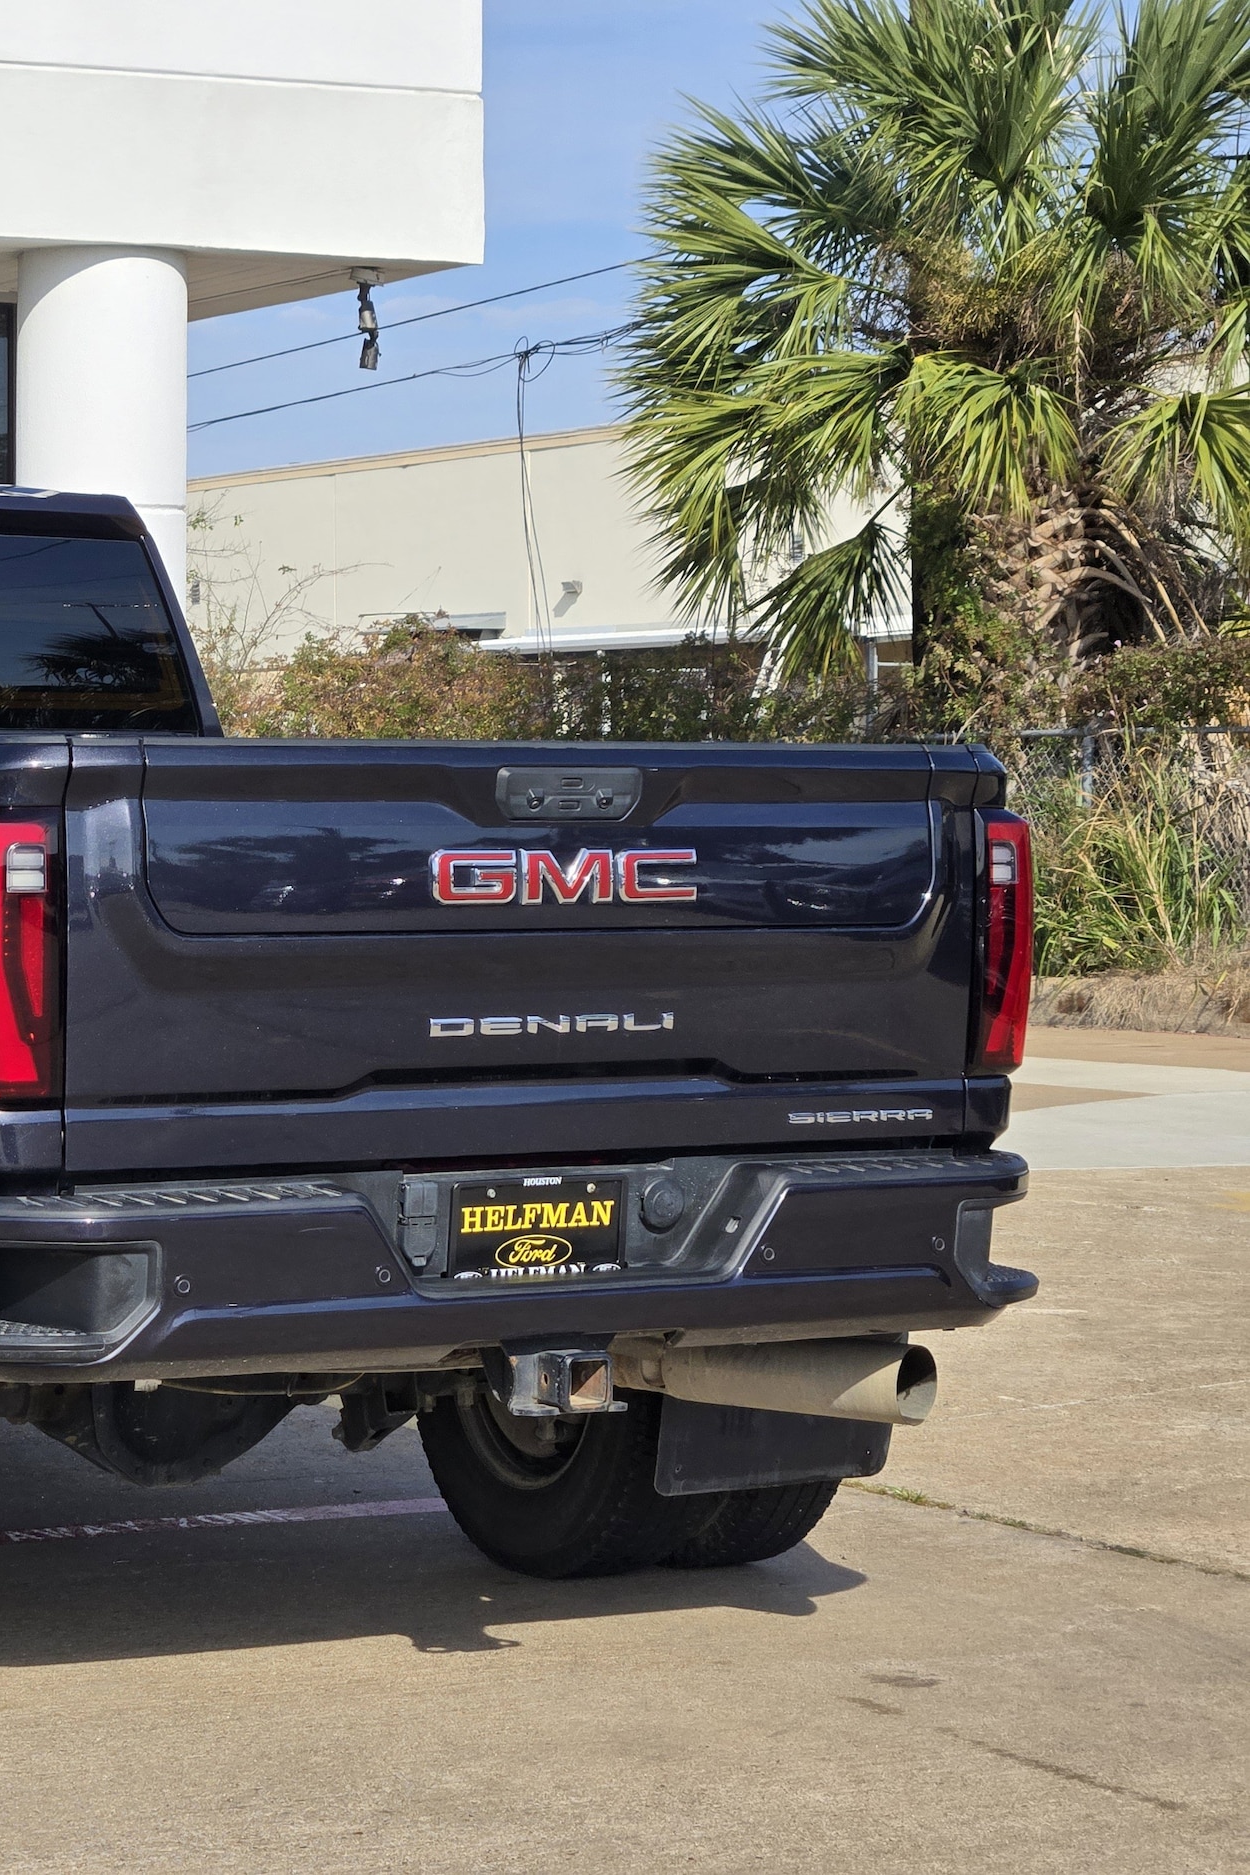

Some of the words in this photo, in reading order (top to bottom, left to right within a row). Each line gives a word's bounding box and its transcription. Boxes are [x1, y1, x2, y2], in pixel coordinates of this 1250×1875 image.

[429, 848, 697, 905] GMC
[429, 1011, 674, 1038] DENALI
[787, 1107, 934, 1125] SIERRA
[523, 1176, 563, 1187] HOUSTON
[460, 1200, 614, 1233] HELFMAN
[509, 1239, 558, 1263] Ford
